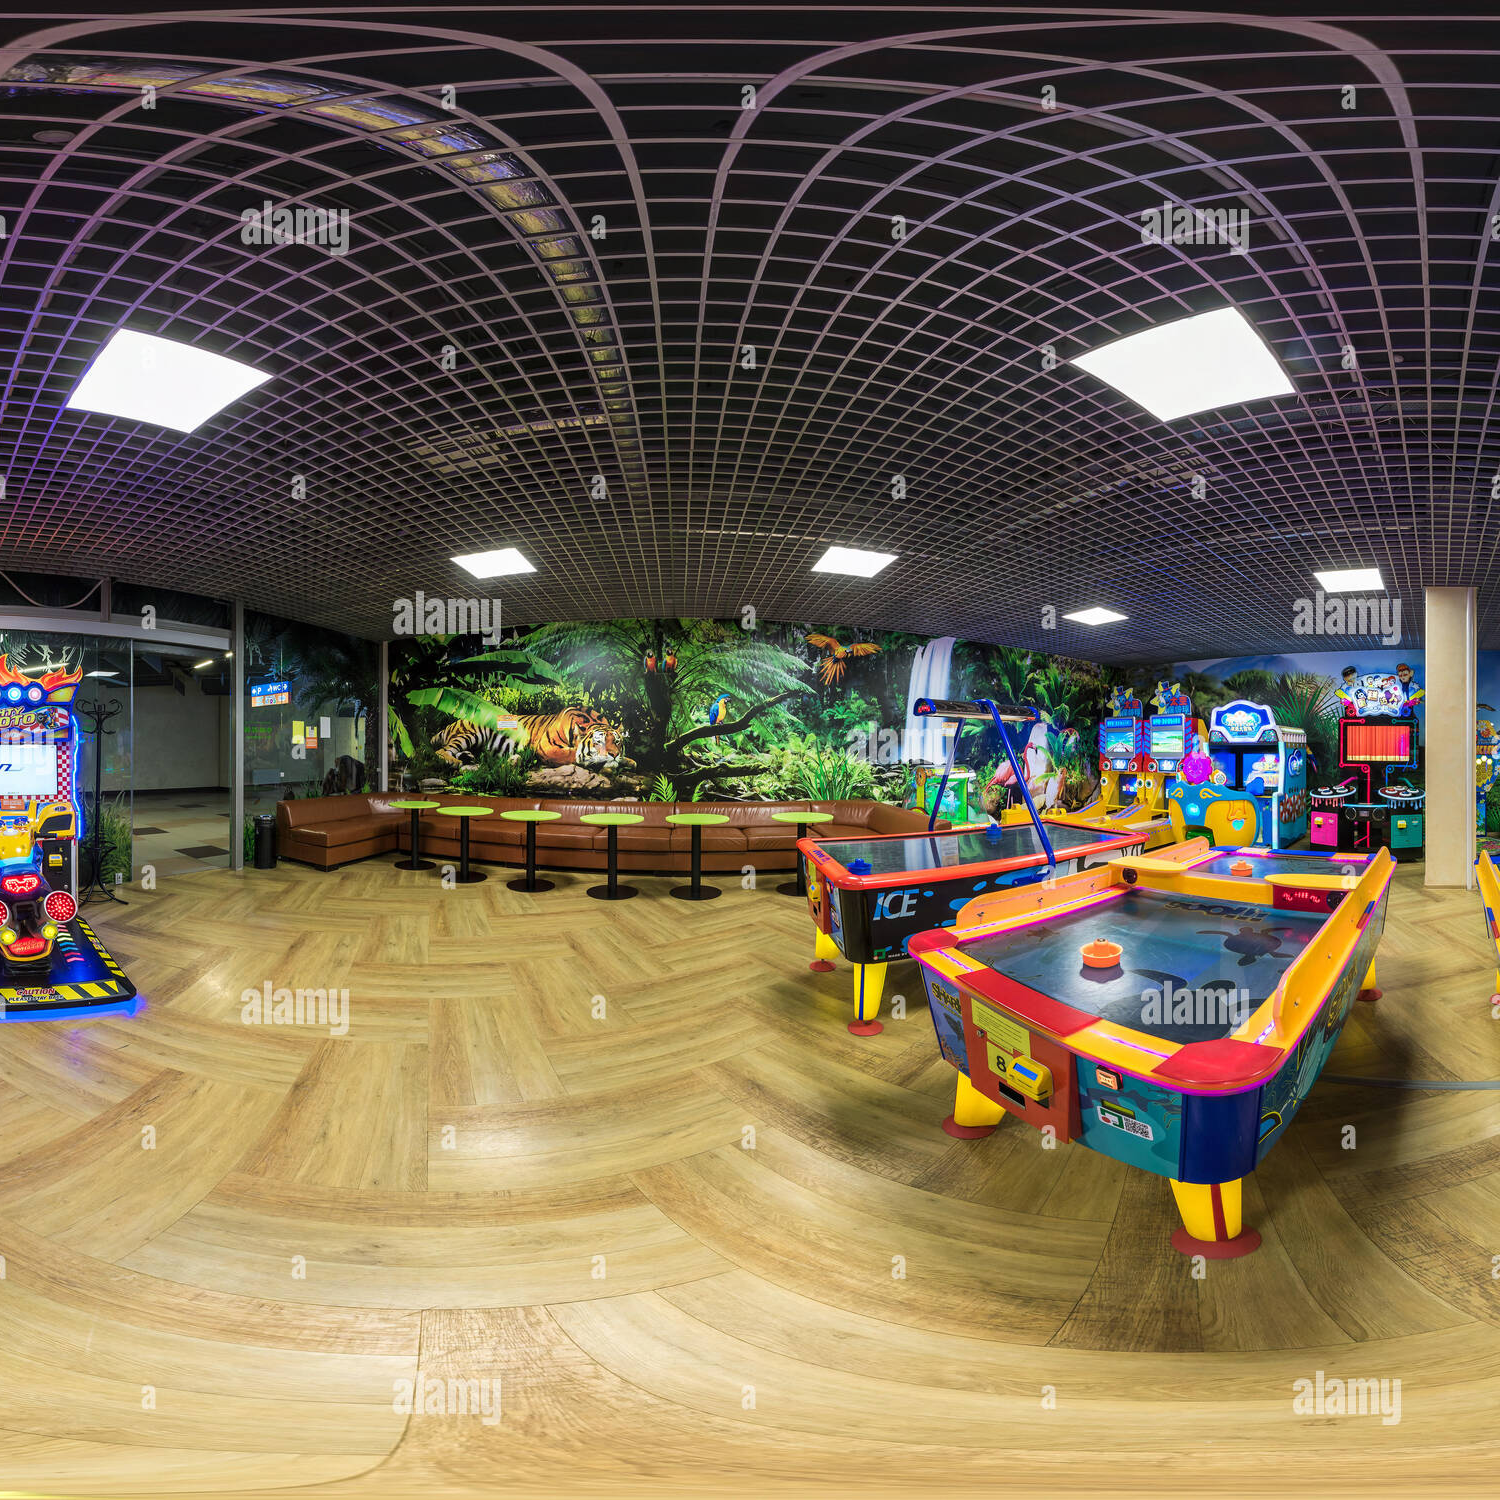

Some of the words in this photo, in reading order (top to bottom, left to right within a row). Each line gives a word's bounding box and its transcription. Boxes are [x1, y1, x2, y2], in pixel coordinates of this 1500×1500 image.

[873, 889, 919, 920] ICE
[16, 988, 56, 996] CAUTION
[996, 1056, 1006, 1072] 8
